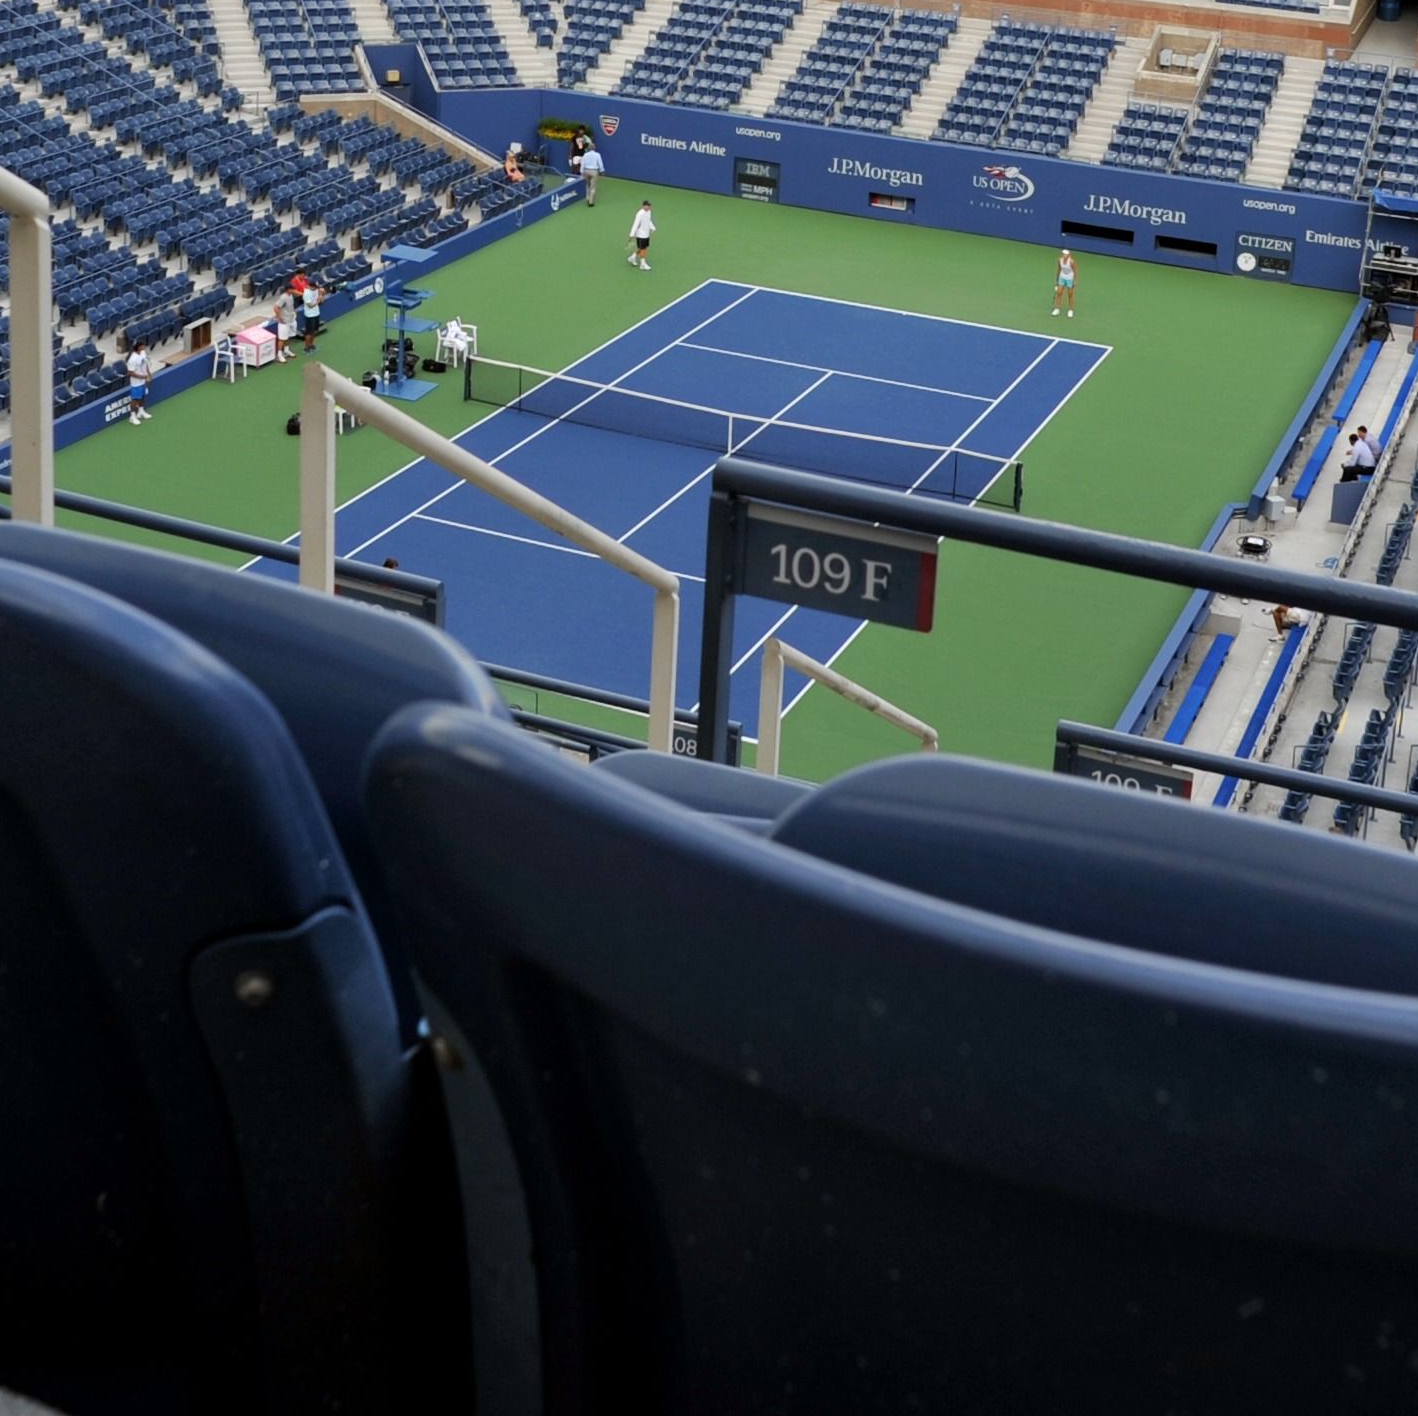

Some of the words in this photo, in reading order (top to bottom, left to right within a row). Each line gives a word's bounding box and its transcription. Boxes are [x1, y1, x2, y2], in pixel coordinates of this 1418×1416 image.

[735, 126, 781, 142] usopen.org
[640, 133, 687, 151] Emirates
[688, 140, 726, 157] Airline
[746, 163, 771, 177] IBM
[827, 156, 924, 187] J.P.Morgan
[753, 185, 773, 196] MPH
[973, 175, 988, 188] US
[989, 178, 1026, 194] OPEN
[1083, 194, 1186, 226] J.P.Morgan
[1242, 198, 1296, 215] usopen.org
[1238, 234, 1294, 252] CITIZEN
[1305, 229, 1362, 249] Emirates
[770, 544, 852, 595] 109
[860, 558, 893, 603] F
